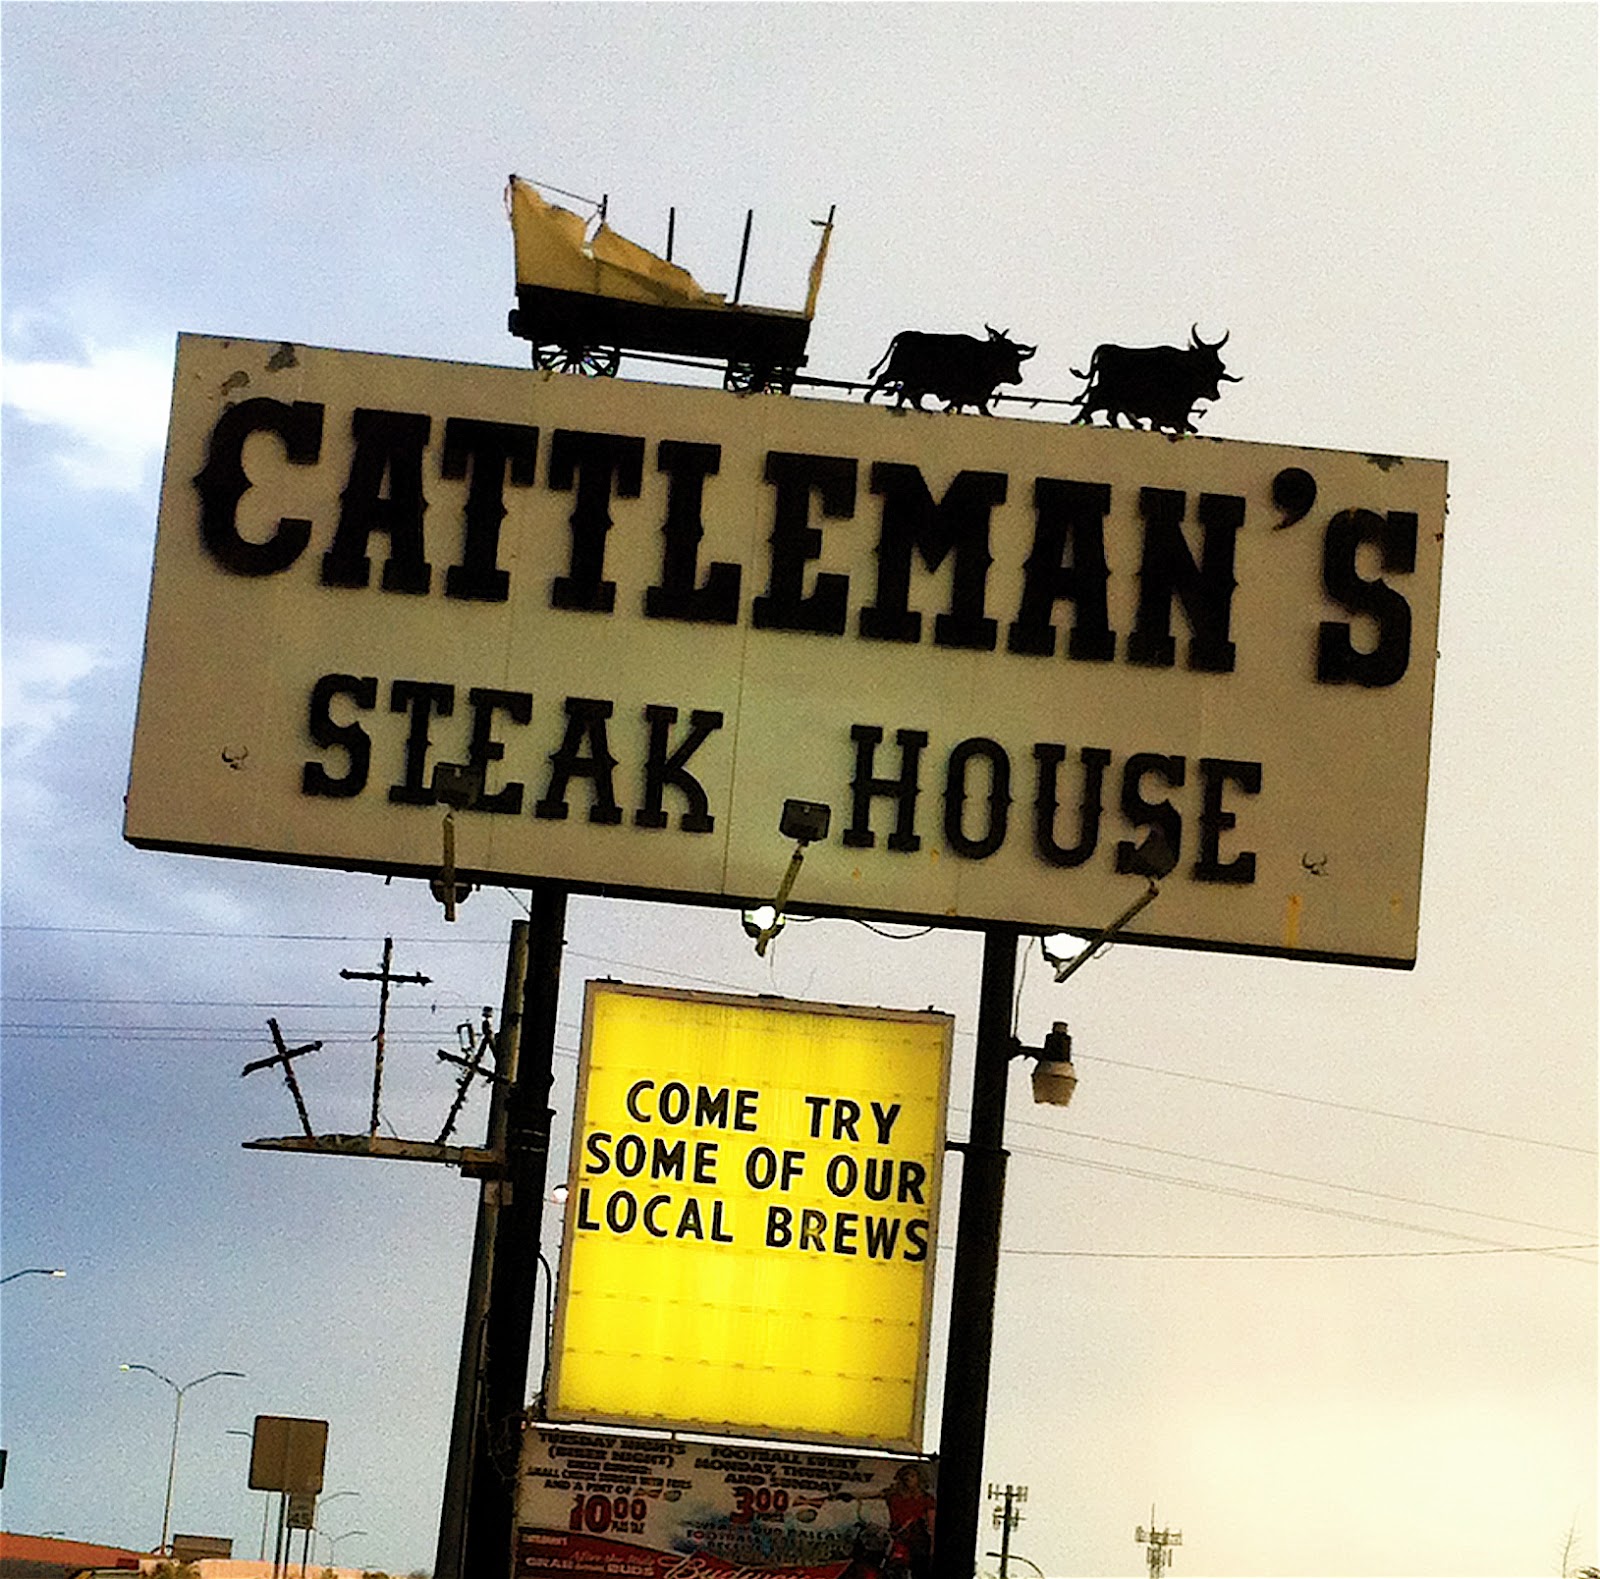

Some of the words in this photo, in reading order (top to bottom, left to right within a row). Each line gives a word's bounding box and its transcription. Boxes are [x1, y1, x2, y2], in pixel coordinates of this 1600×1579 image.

[192, 396, 1418, 688] CATTLEMAN'S
[302, 673, 724, 833] STEAK
[842, 724, 1263, 885] HOUSE
[626, 1080, 759, 1132] COME
[805, 1096, 901, 1145] TRY
[585, 1132, 719, 1184] SOME
[745, 1146, 806, 1191] OF
[826, 1154, 926, 1205] OUR
[577, 1188, 733, 1243] LOCAL
[765, 1206, 929, 1262] BREWS
[538, 1432, 616, 1450] TUESDAY
[711, 1447, 802, 1465] FOOTBALL
[808, 1457, 861, 1471] EVERY
[543, 1479, 571, 1490] AND
[573, 1481, 584, 1491] A
[616, 1484, 633, 1495] OF
[723, 1473, 765, 1486] AND
[769, 1477, 843, 1492] SUNDAY
[781, 1465, 875, 1483] THURSDAY
